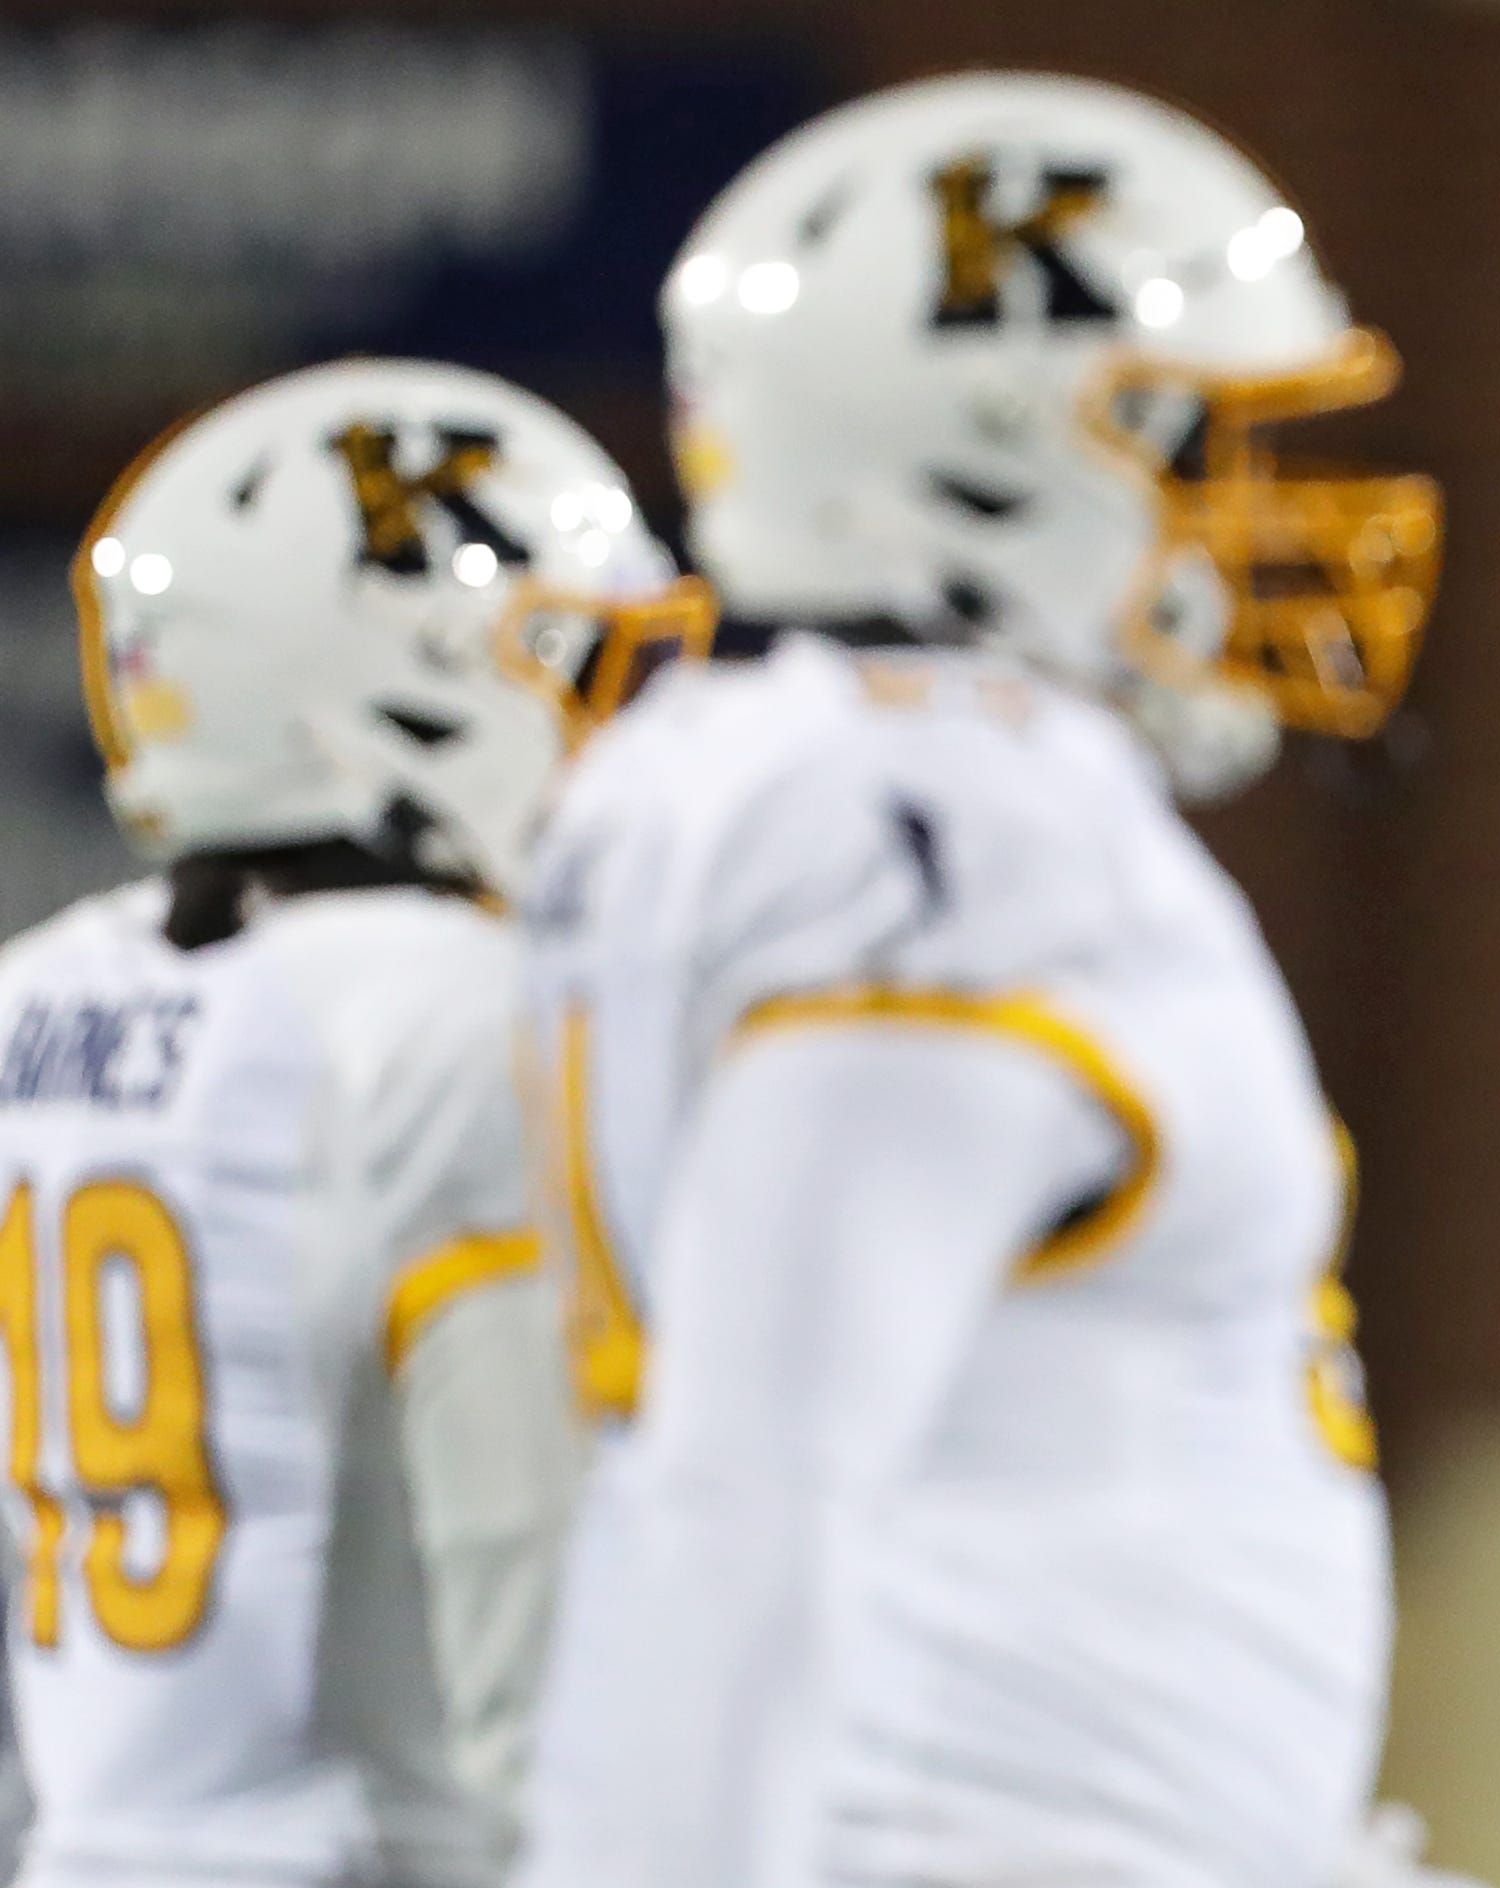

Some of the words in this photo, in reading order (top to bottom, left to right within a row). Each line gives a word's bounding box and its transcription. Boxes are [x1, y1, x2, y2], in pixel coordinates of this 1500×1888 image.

[929, 150, 1116, 332] K
[325, 420, 531, 577] K
[0, 1172, 228, 1654] 19
